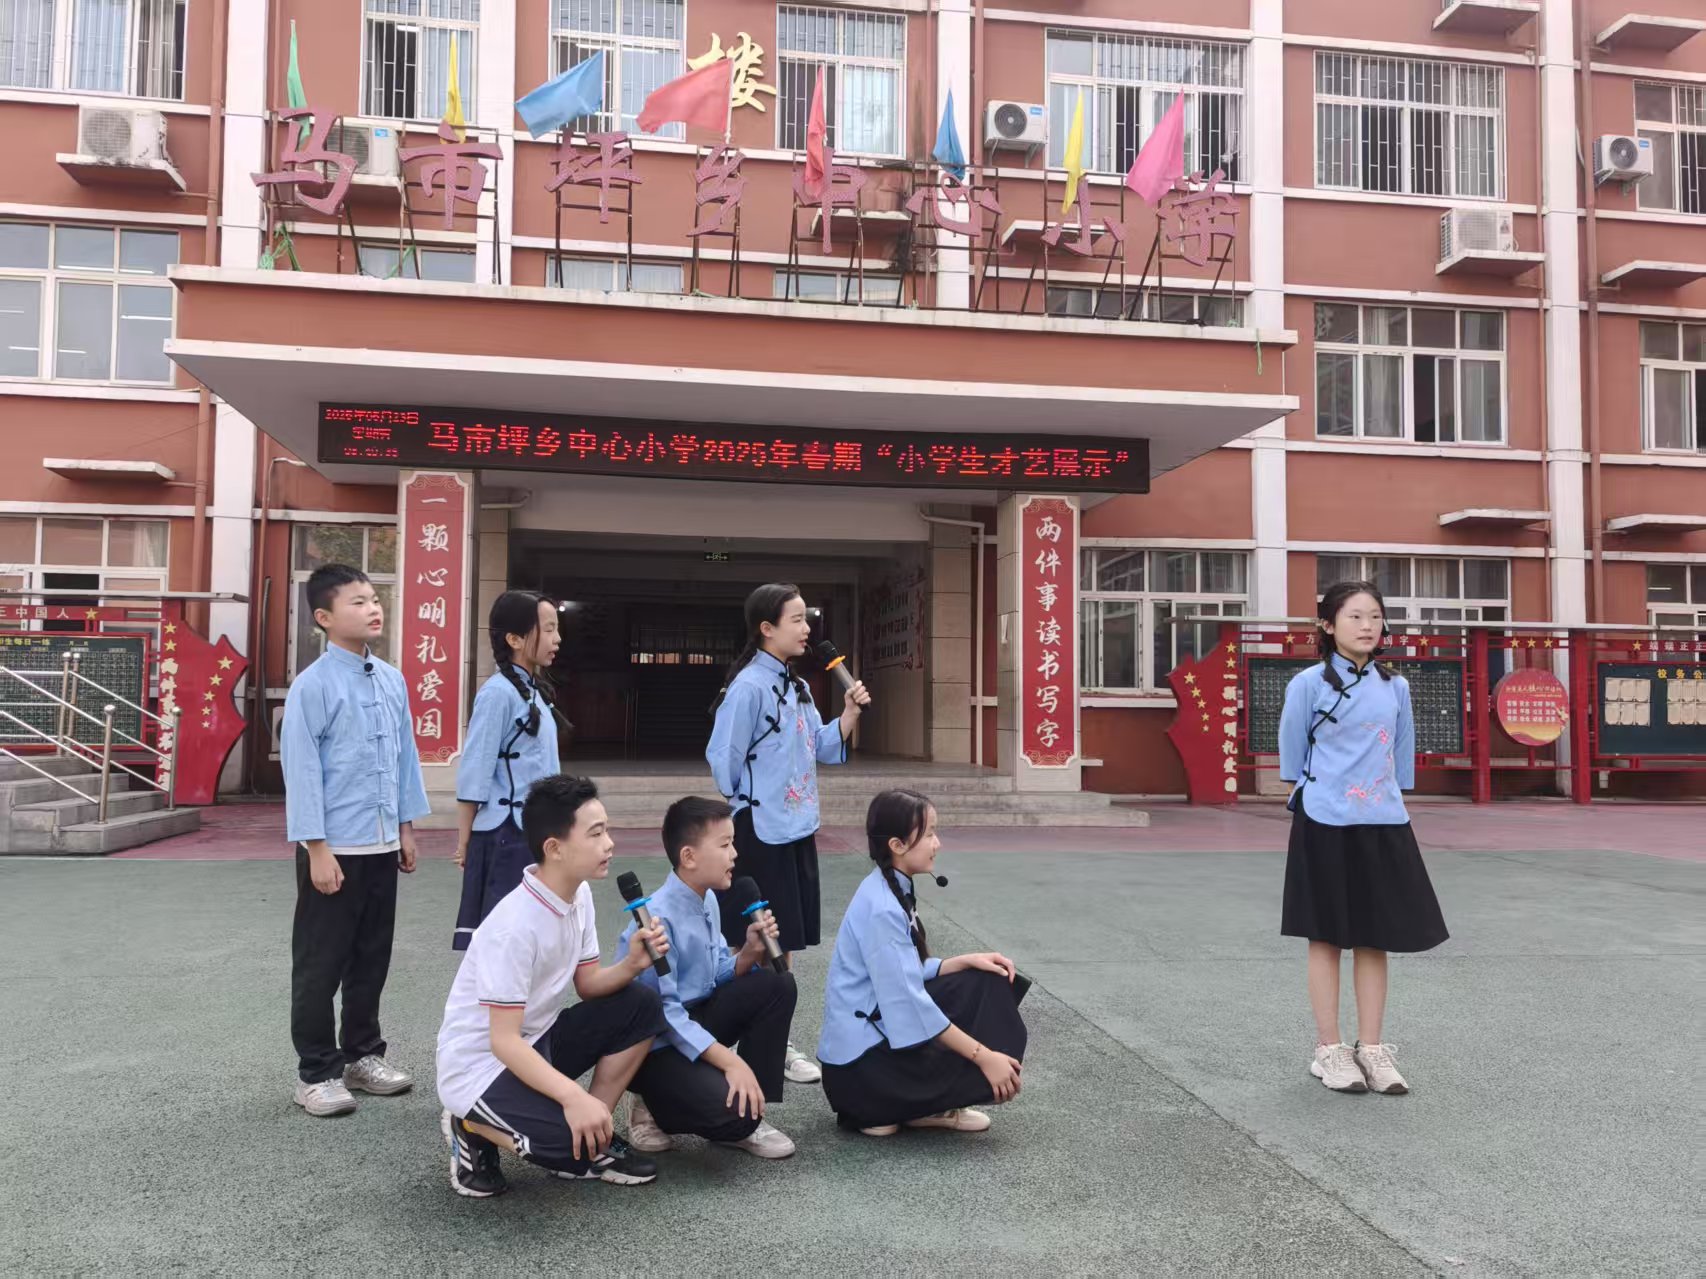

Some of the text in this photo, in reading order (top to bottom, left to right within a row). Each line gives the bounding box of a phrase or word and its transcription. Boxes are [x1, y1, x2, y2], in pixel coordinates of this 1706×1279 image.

[249, 107, 1240, 266] 马市坪乡中心小学
[415, 496, 449, 740] 一颗心明礼爱国
[1035, 516, 1062, 748] 两件事读书写字
